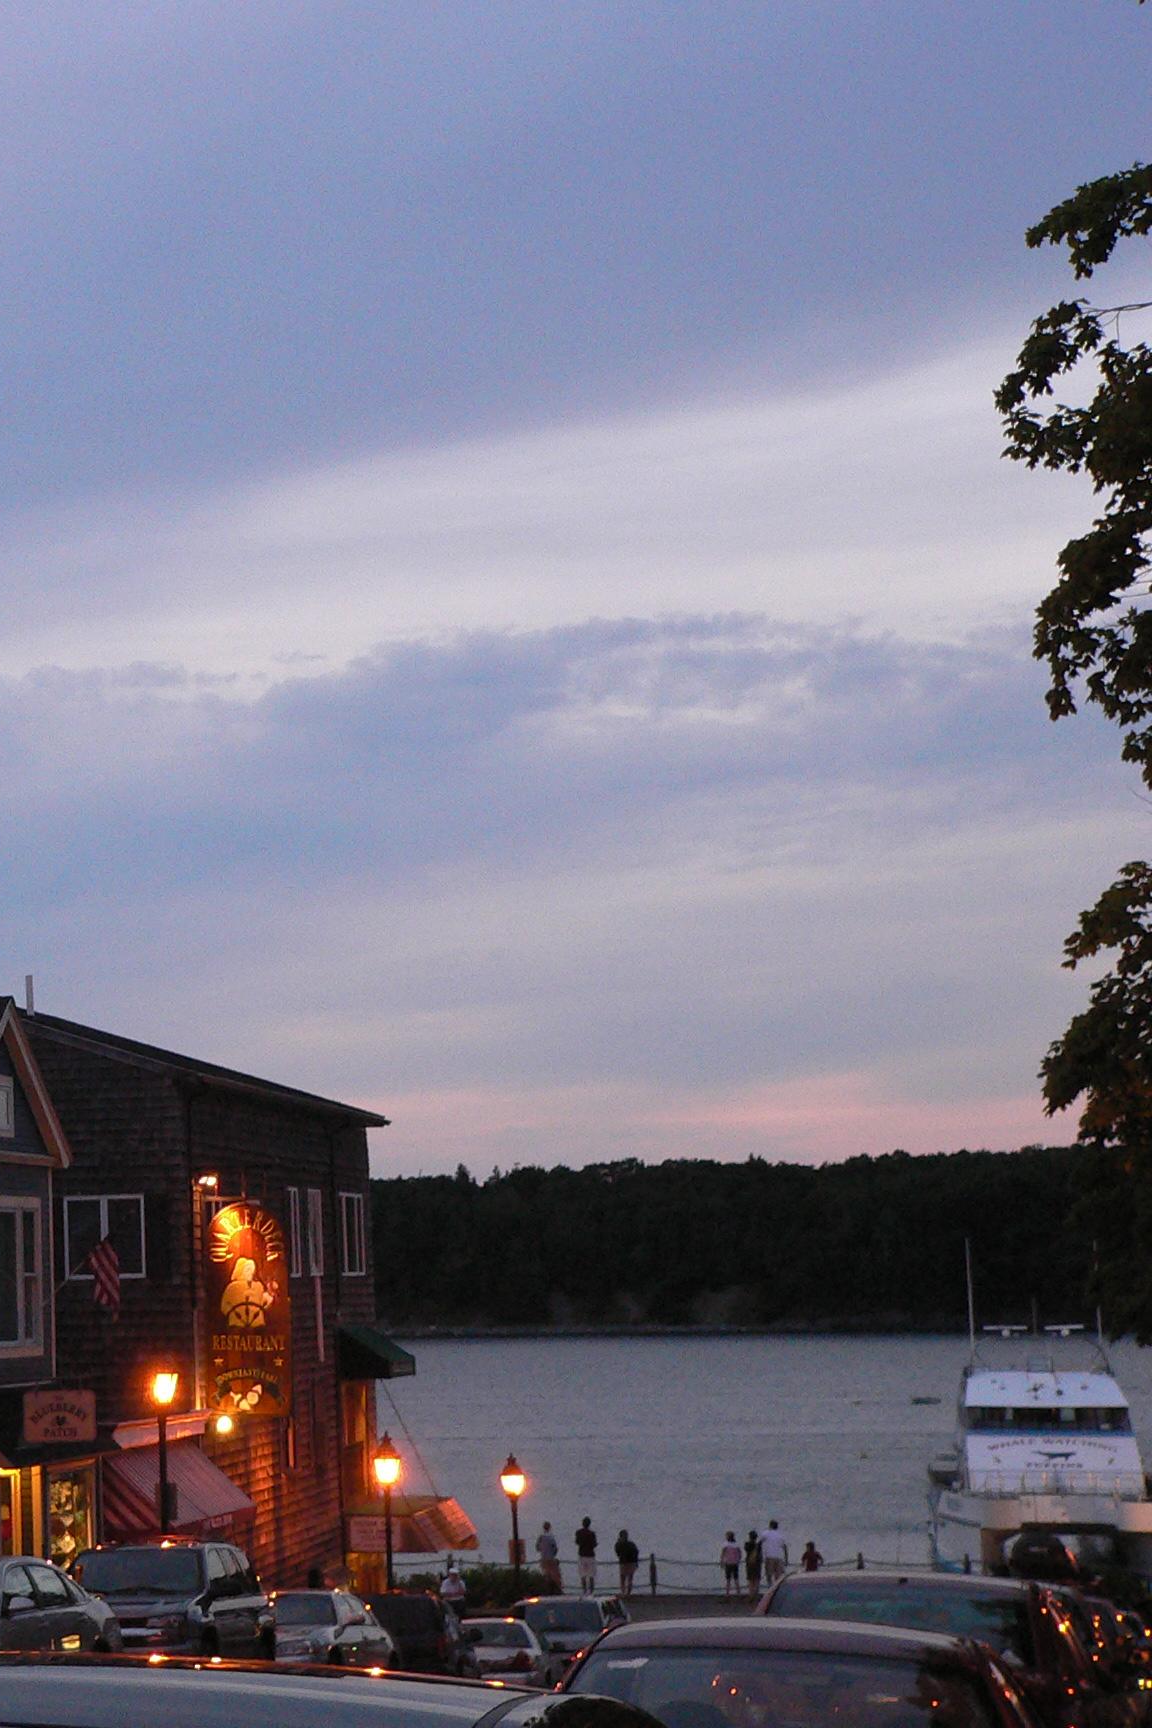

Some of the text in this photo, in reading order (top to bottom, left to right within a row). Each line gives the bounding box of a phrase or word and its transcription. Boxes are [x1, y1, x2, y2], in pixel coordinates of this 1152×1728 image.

[213, 1334, 286, 1352] RESTAURANT
[30, 1402, 87, 1425] BLUEBERRY
[44, 1427, 77, 1438] PATCH
